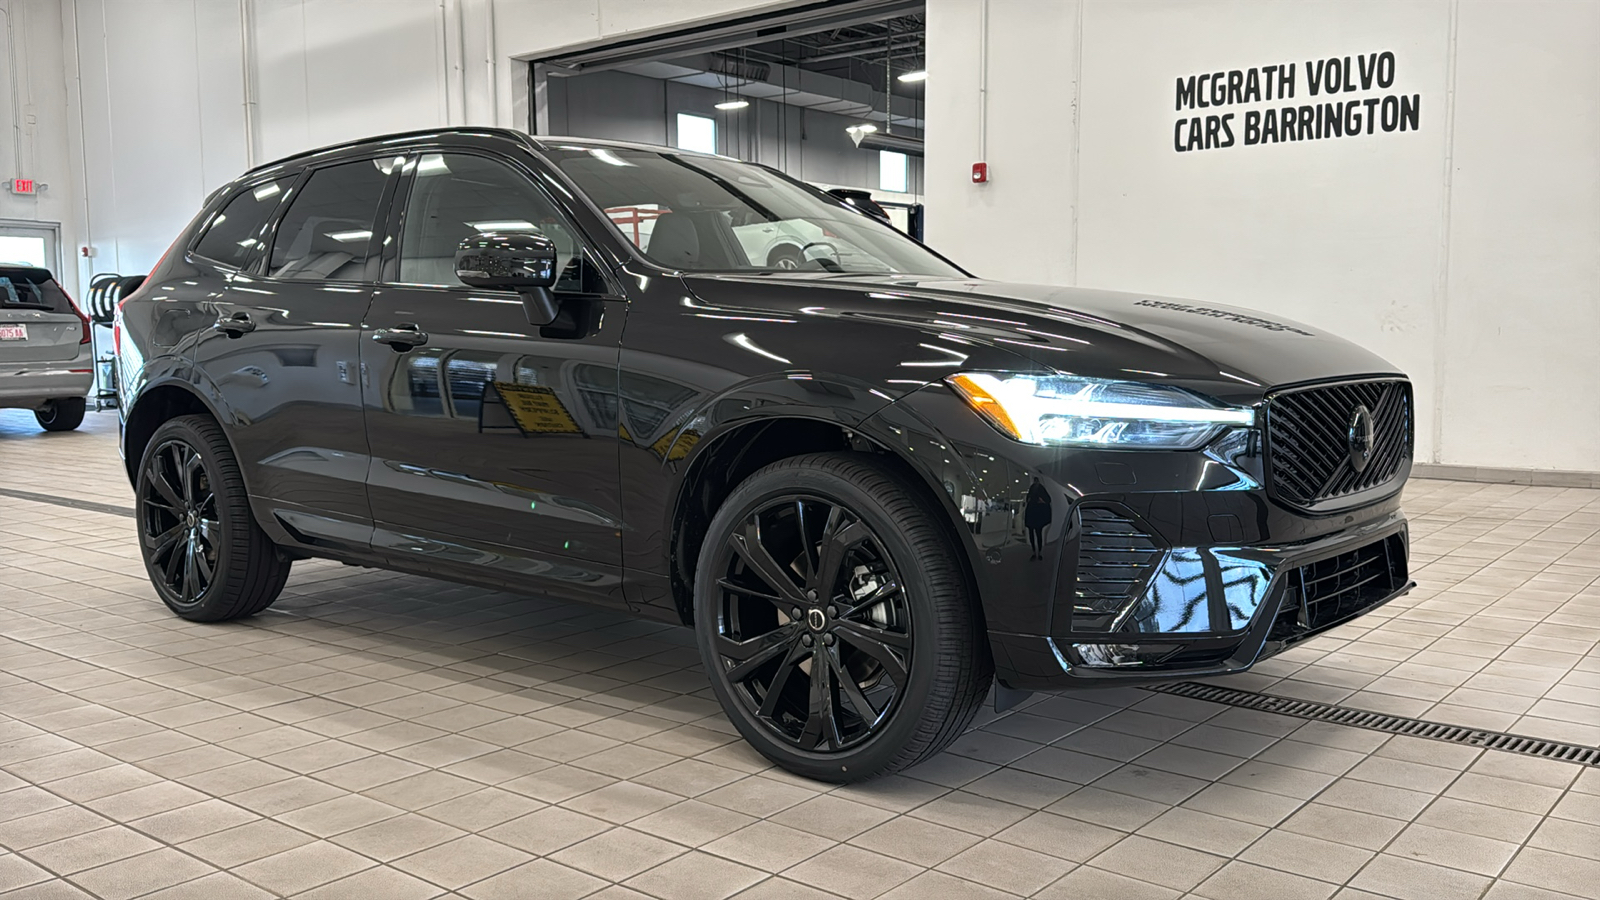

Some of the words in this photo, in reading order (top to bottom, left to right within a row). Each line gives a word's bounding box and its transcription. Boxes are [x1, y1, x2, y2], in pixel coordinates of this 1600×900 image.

[1175, 63, 1296, 111] MCGRATH
[1306, 51, 1395, 96] VOLVO
[1174, 113, 1235, 152] CARS
[1244, 94, 1420, 145] BARRINGTON
[16, 179, 33, 193] EXIT
